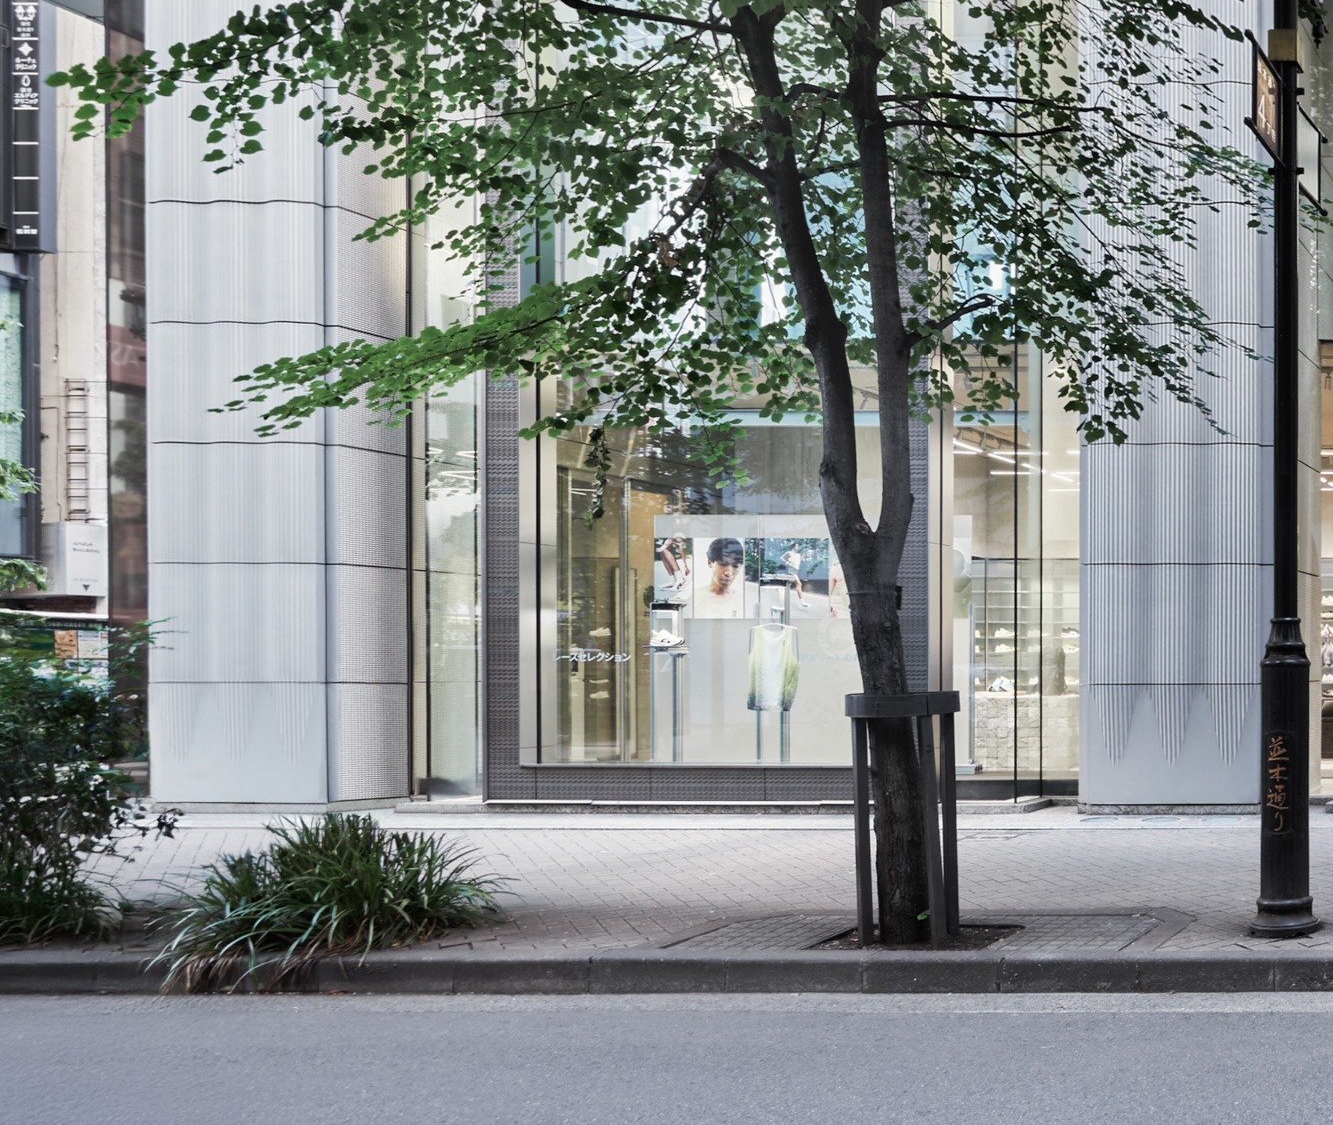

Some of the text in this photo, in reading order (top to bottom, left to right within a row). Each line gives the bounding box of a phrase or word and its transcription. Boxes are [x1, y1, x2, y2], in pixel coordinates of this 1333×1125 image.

[552, 651, 632, 663] レースセレクション
